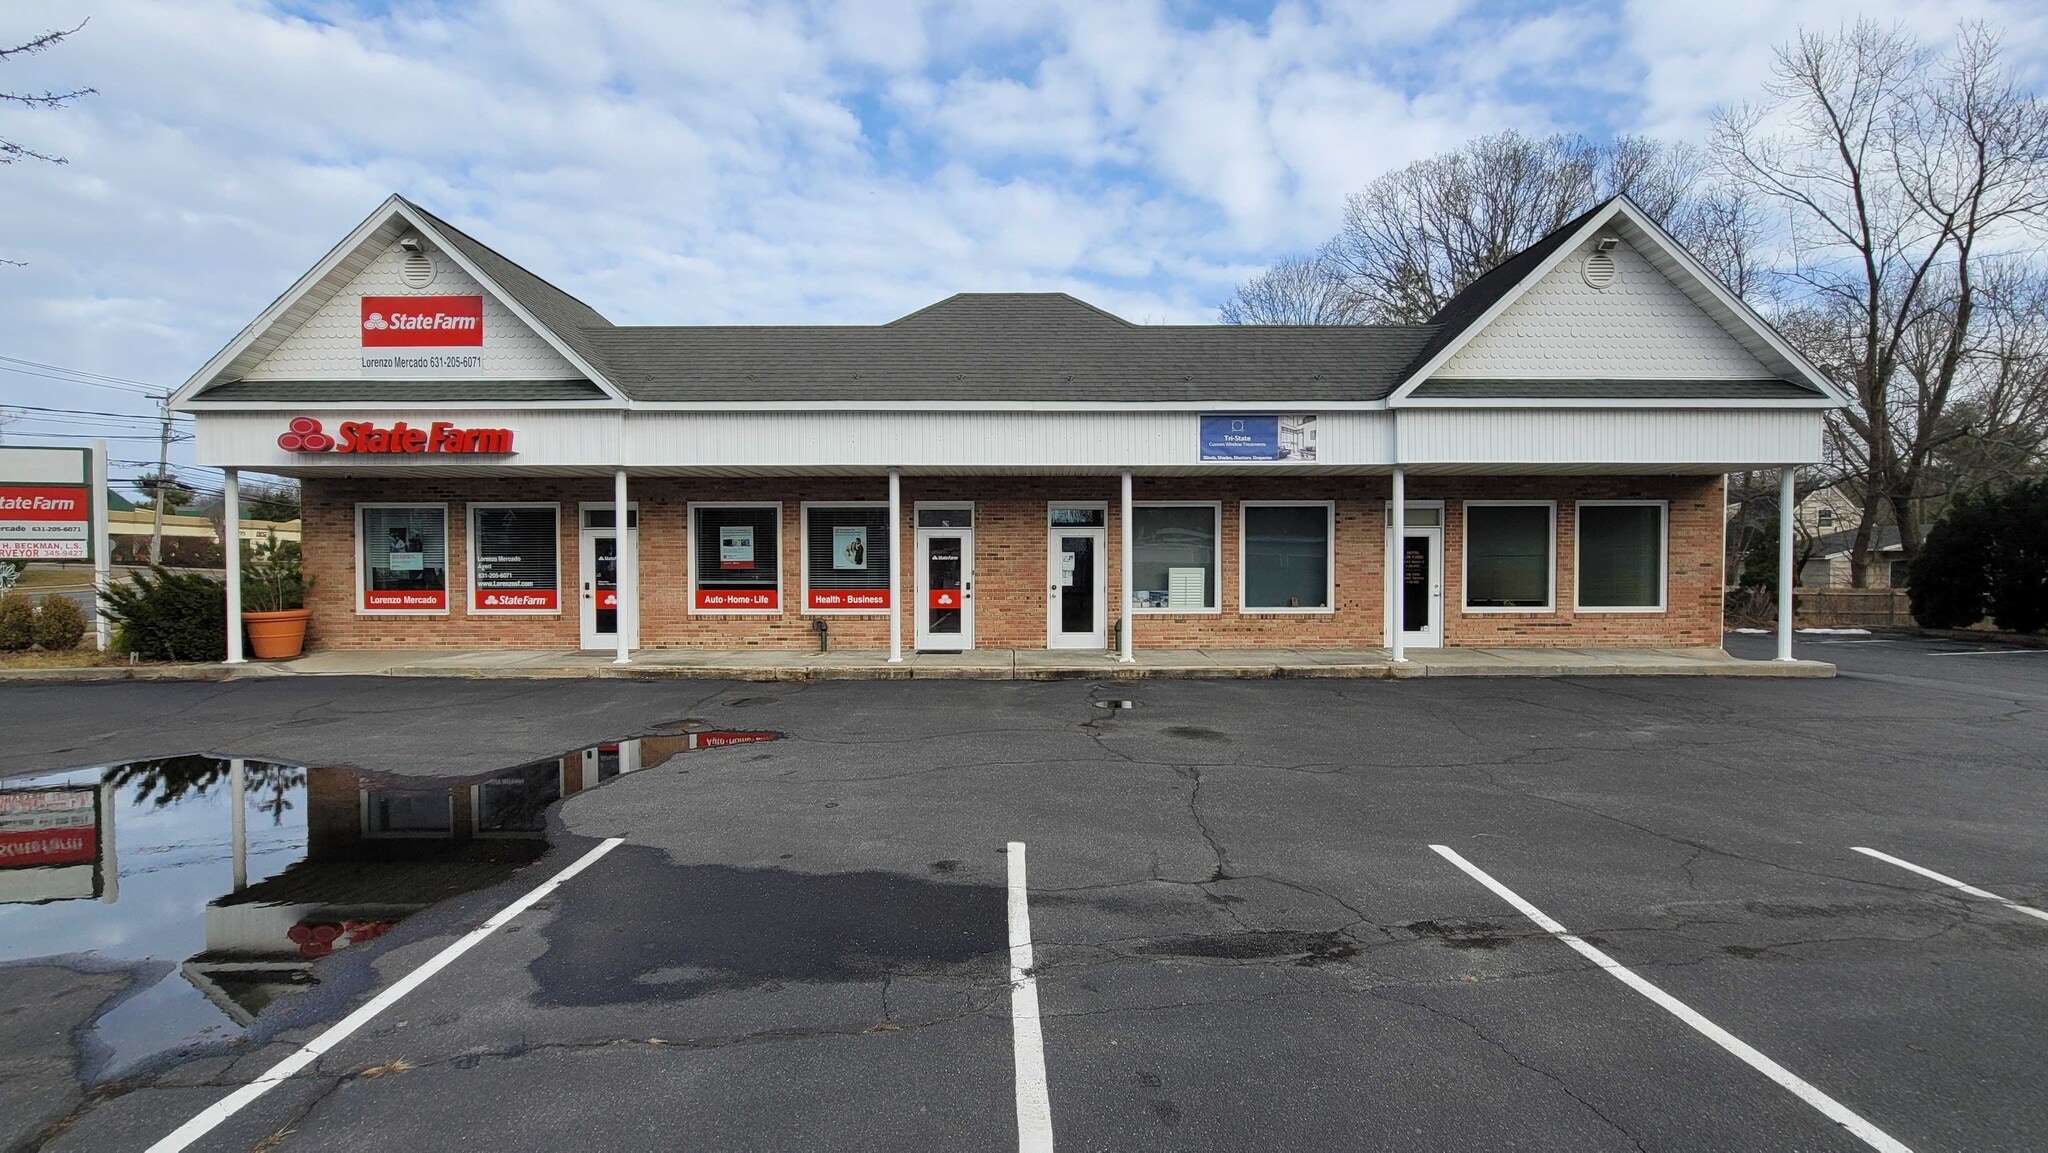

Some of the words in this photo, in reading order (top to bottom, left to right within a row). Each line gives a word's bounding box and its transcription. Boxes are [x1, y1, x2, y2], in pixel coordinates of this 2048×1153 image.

[362, 357, 392, 368] Lorenzo
[394, 357, 428, 368] Mercado
[430, 357, 481, 368] 631-205-6071
